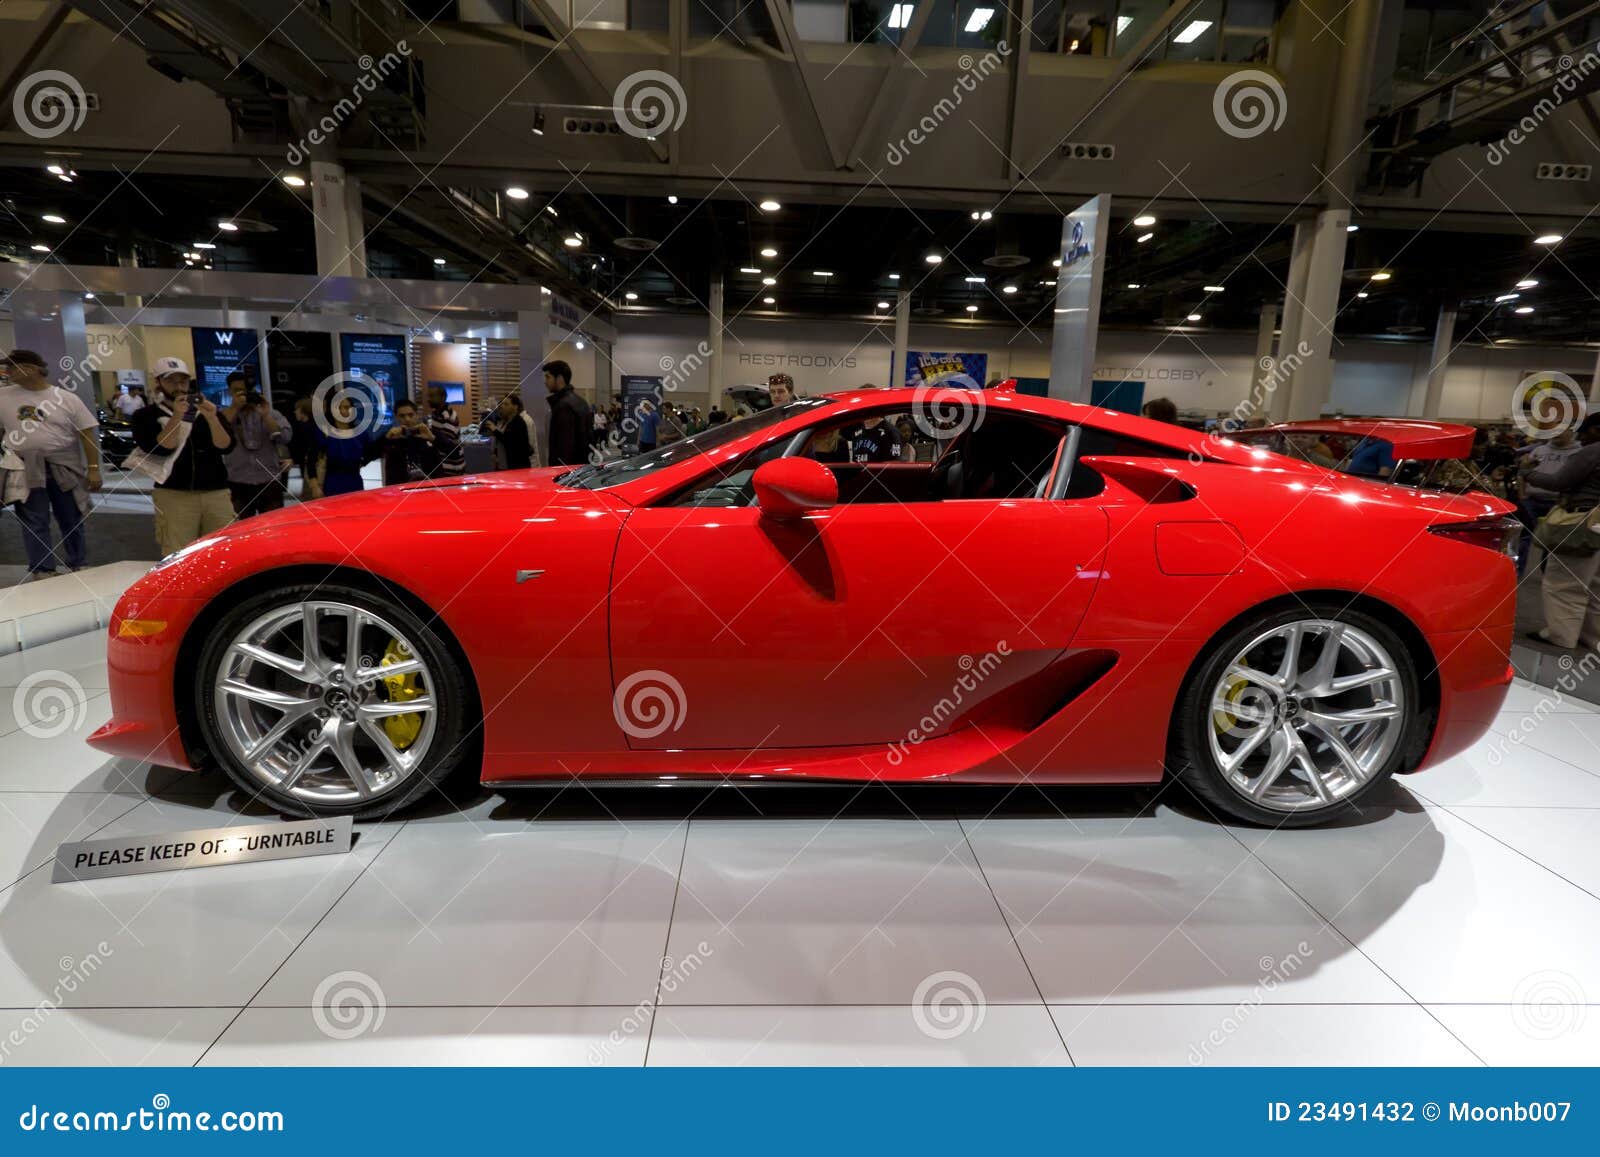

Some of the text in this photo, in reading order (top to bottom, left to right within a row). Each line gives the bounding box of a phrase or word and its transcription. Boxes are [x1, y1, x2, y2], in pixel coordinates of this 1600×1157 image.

[215, 331, 234, 345] W
[739, 353, 857, 368] RESTROOMS
[1147, 368, 1207, 381] LOBBY
[74, 846, 145, 868] PLEASE
[150, 841, 196, 861] KEEP
